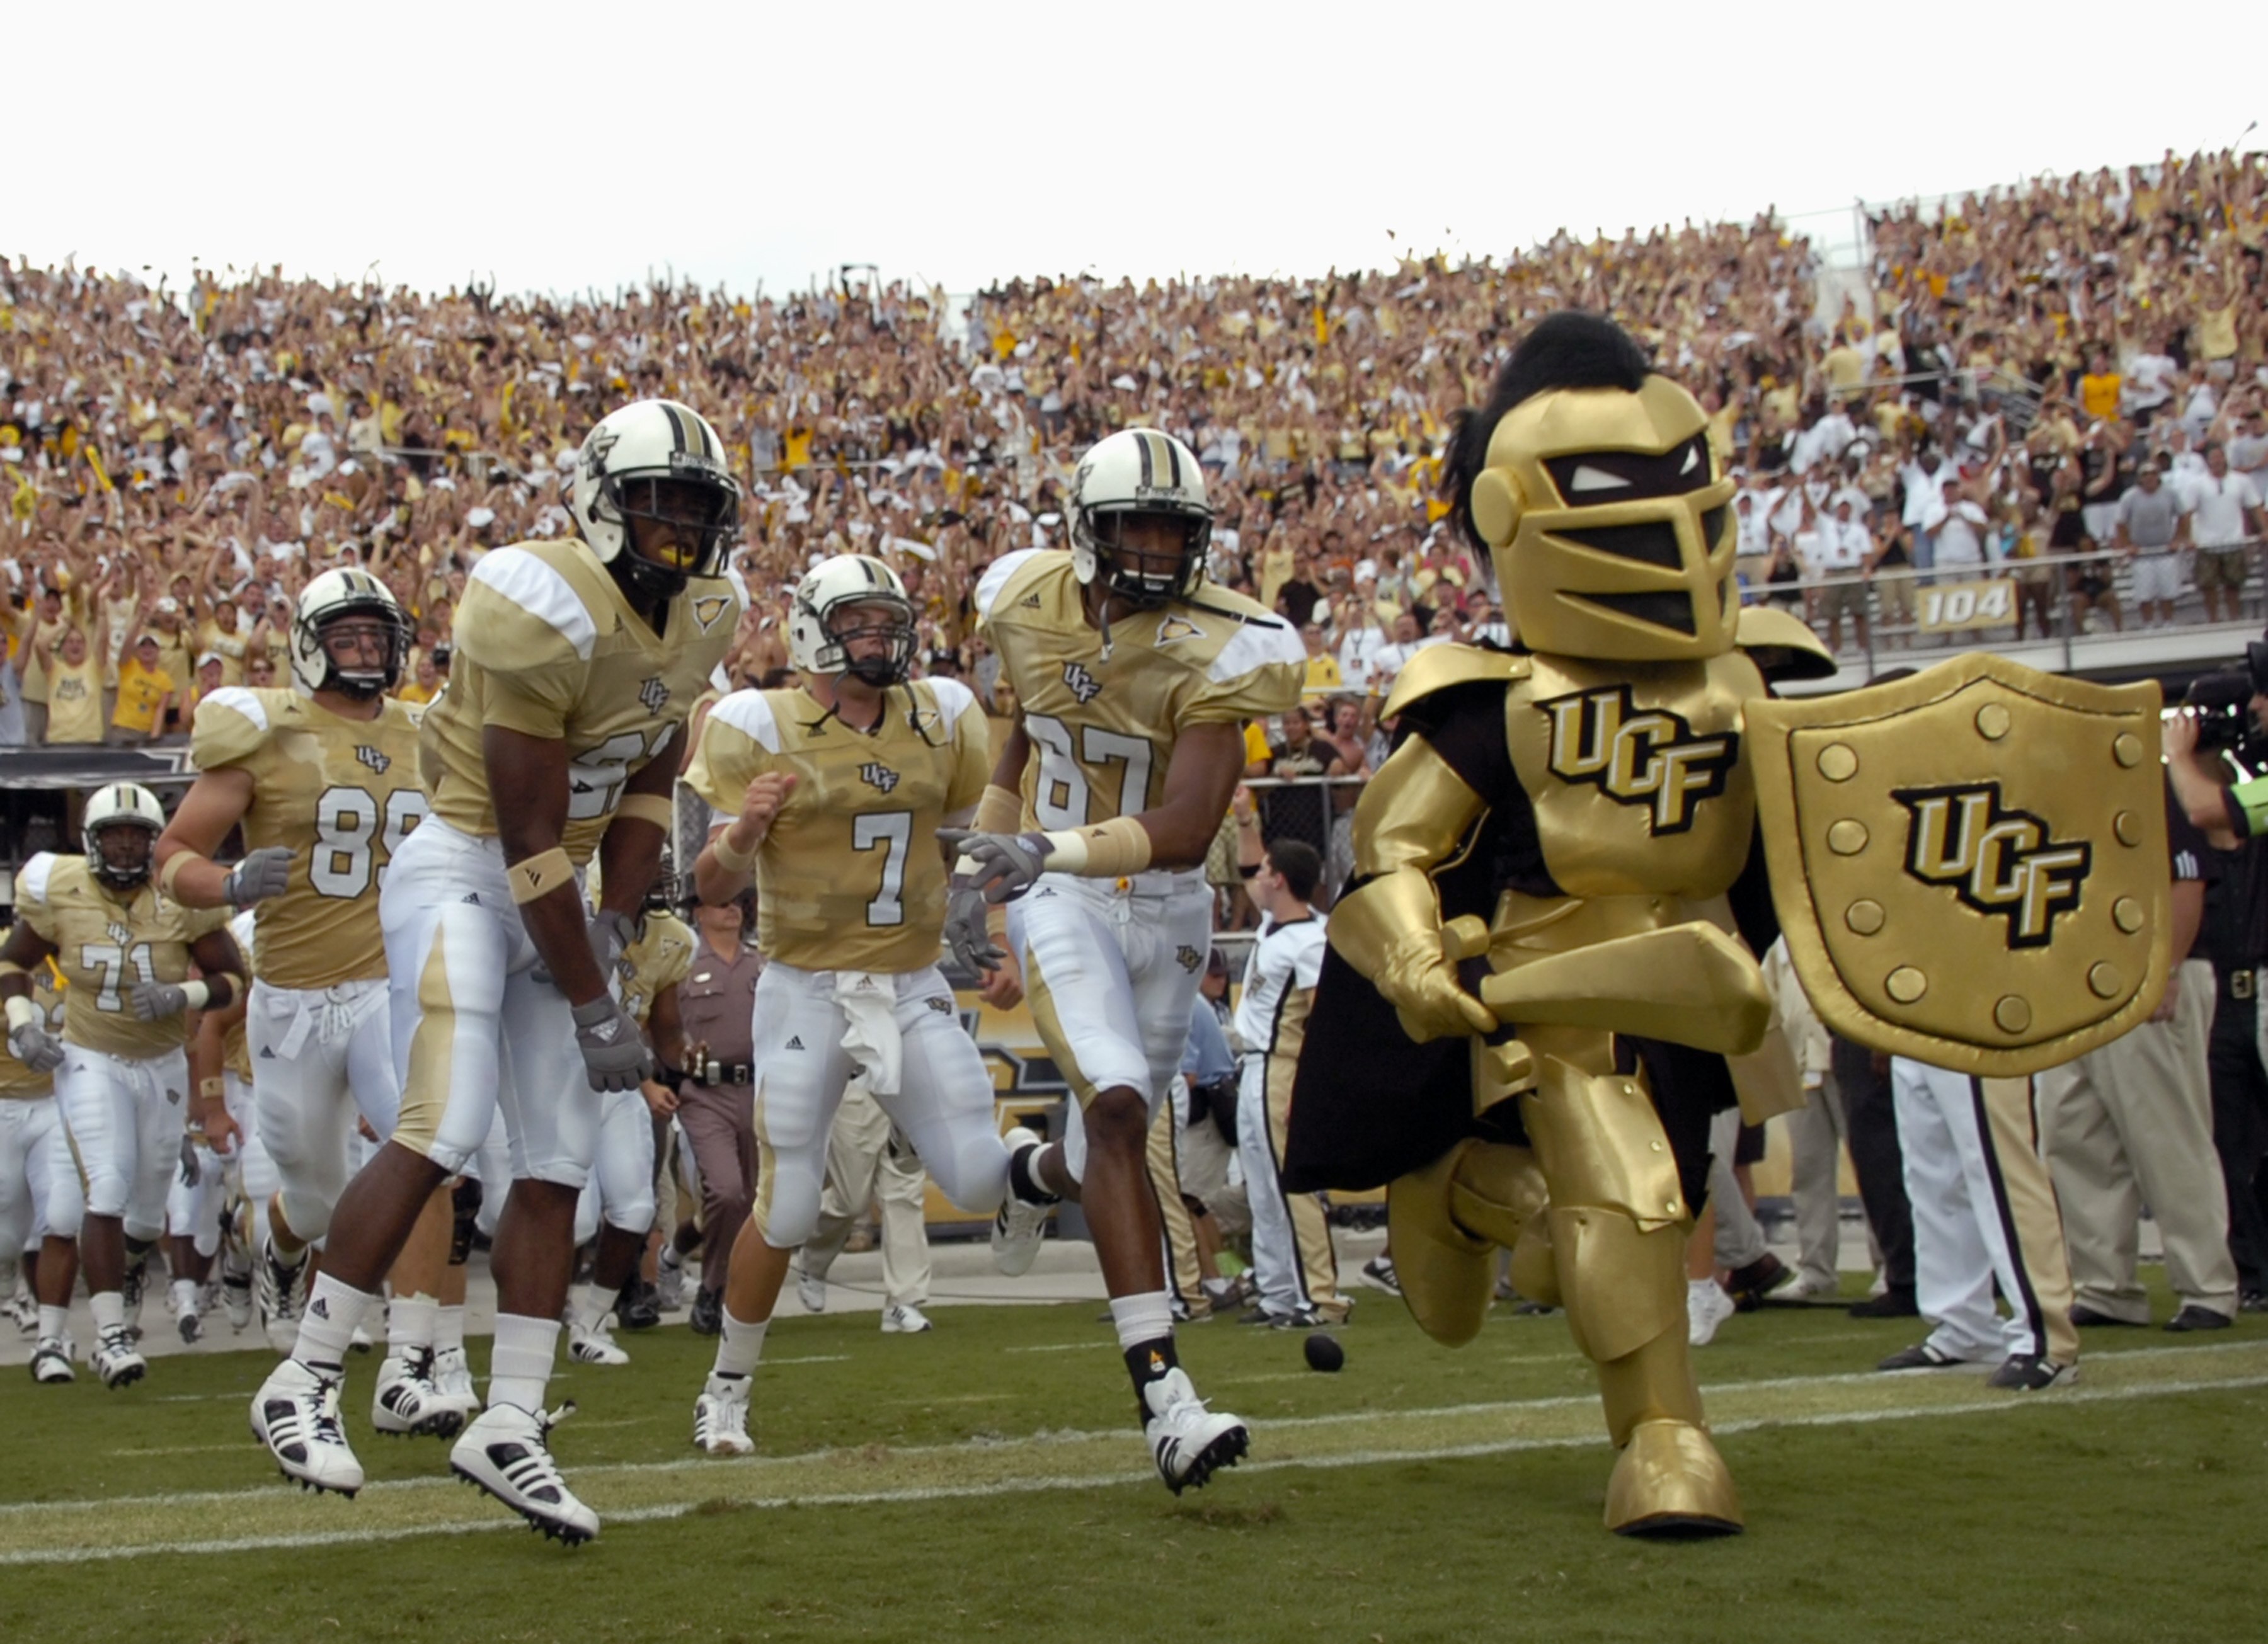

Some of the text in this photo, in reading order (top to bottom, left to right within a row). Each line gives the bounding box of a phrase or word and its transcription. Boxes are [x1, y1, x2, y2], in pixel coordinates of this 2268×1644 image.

[1927, 585, 2009, 625] 104
[1062, 661, 1103, 704] UCF
[353, 745, 392, 775] UCF
[857, 762, 900, 795] UCF
[1023, 711, 1154, 832] 87
[1533, 683, 1741, 837] UCF
[852, 809, 914, 927] 7
[1889, 781, 2092, 951] UCF
[80, 942, 155, 1012] 71
